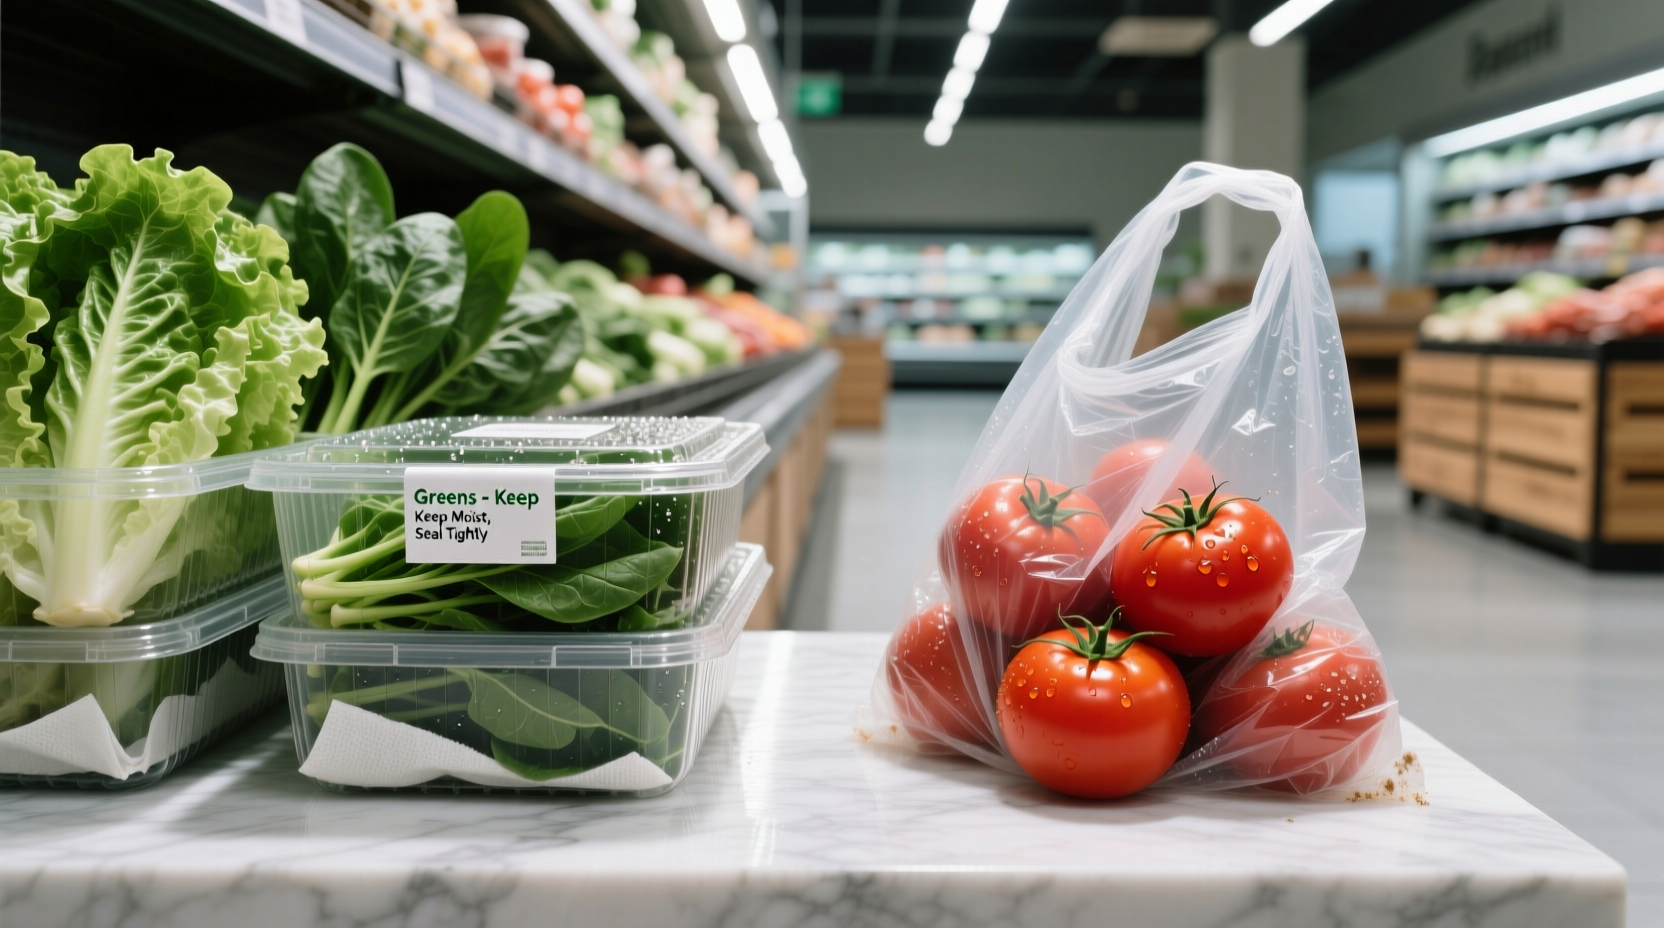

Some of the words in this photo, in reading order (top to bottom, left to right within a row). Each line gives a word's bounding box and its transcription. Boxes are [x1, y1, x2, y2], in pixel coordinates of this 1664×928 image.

[414, 488, 477, 505] Greens
[495, 489, 539, 510] Keep
[415, 510, 448, 526] Keep
[415, 526, 443, 540] Seal
